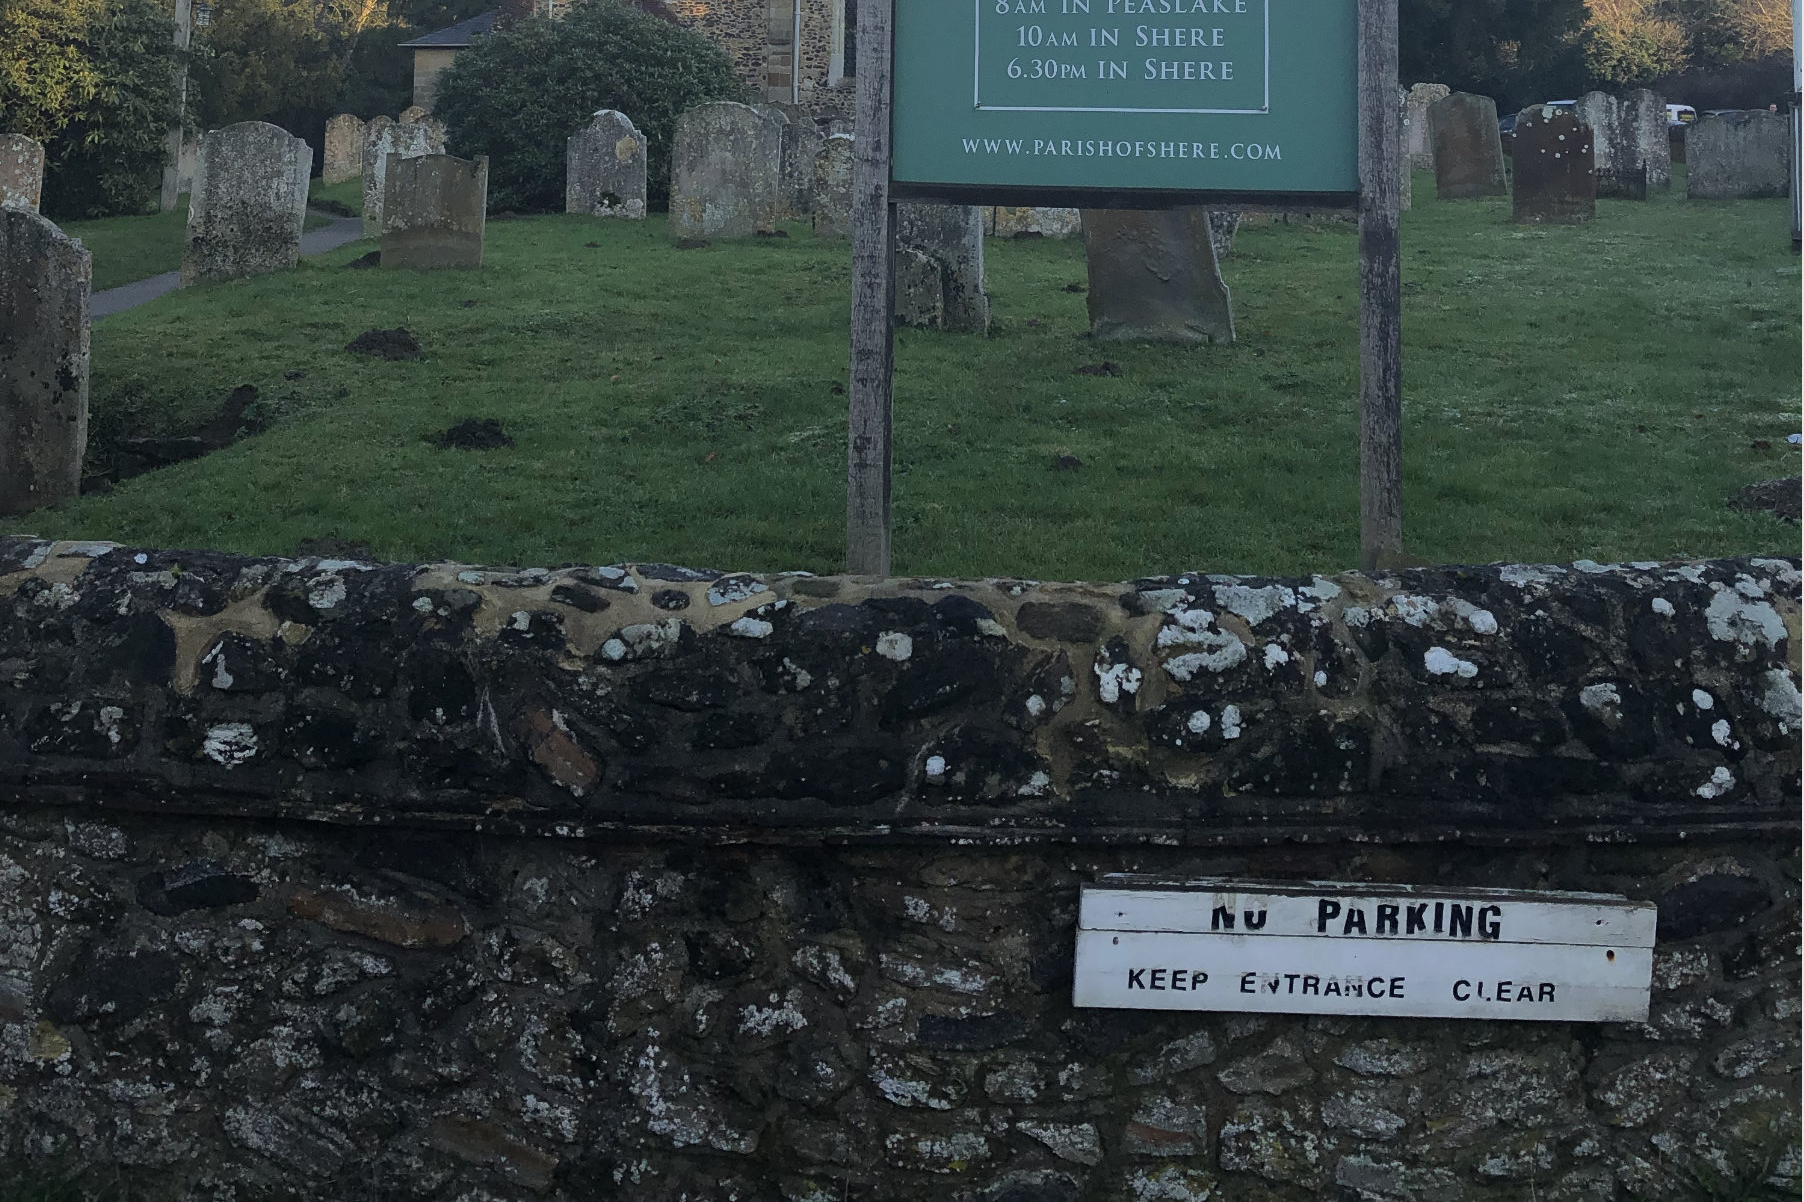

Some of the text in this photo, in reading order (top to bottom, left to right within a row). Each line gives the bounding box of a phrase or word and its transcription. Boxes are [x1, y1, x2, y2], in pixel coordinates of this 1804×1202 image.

[1089, 28, 1120, 47] IN
[1135, 24, 1226, 47] SHERE
[1097, 60, 1129, 80] IN
[1144, 57, 1234, 81] SHERE
[961, 138, 1283, 161] WWW.PARISHOFSHERE.COM
[1316, 896, 1503, 940] PARKING
[1127, 968, 1209, 991] KEEP
